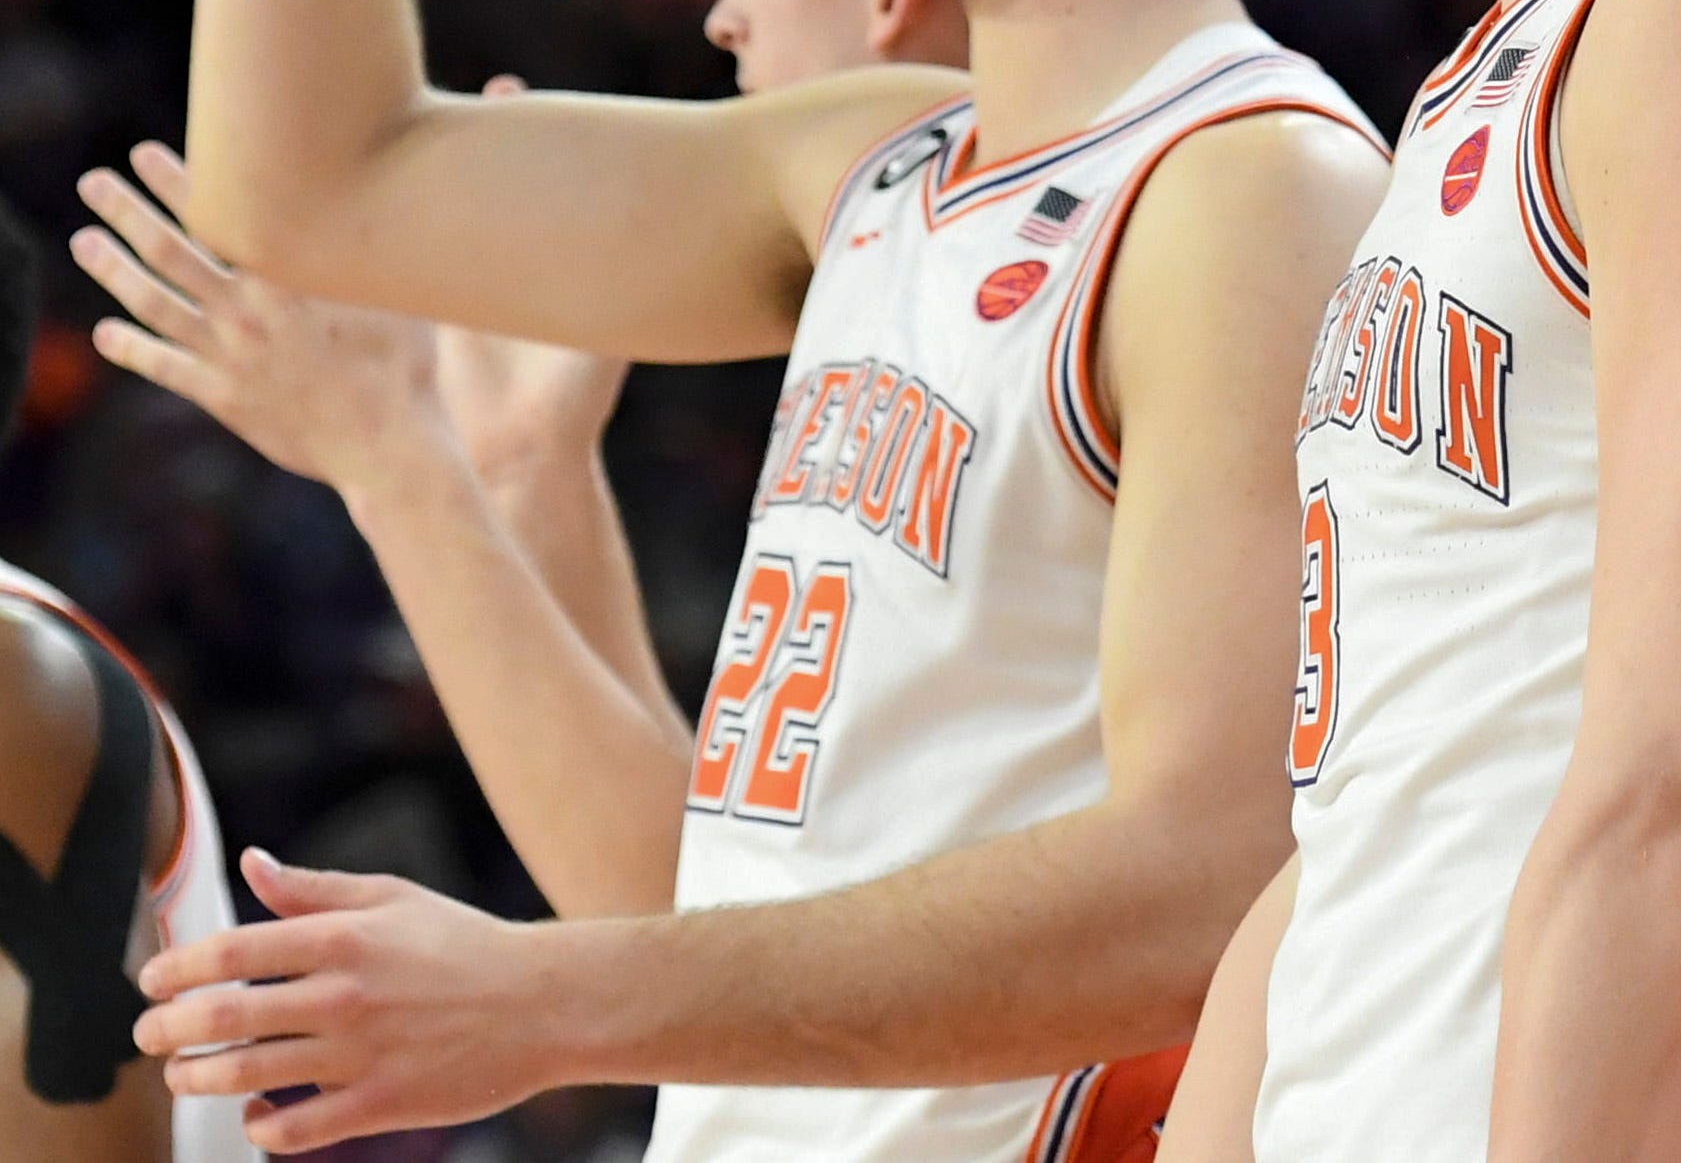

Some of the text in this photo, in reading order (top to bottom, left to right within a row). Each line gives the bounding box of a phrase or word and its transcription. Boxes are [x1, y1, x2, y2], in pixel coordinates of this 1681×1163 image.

[1296, 256, 1514, 506] MSON
[686, 552, 854, 825] 22
[1289, 478, 1341, 787] 3
